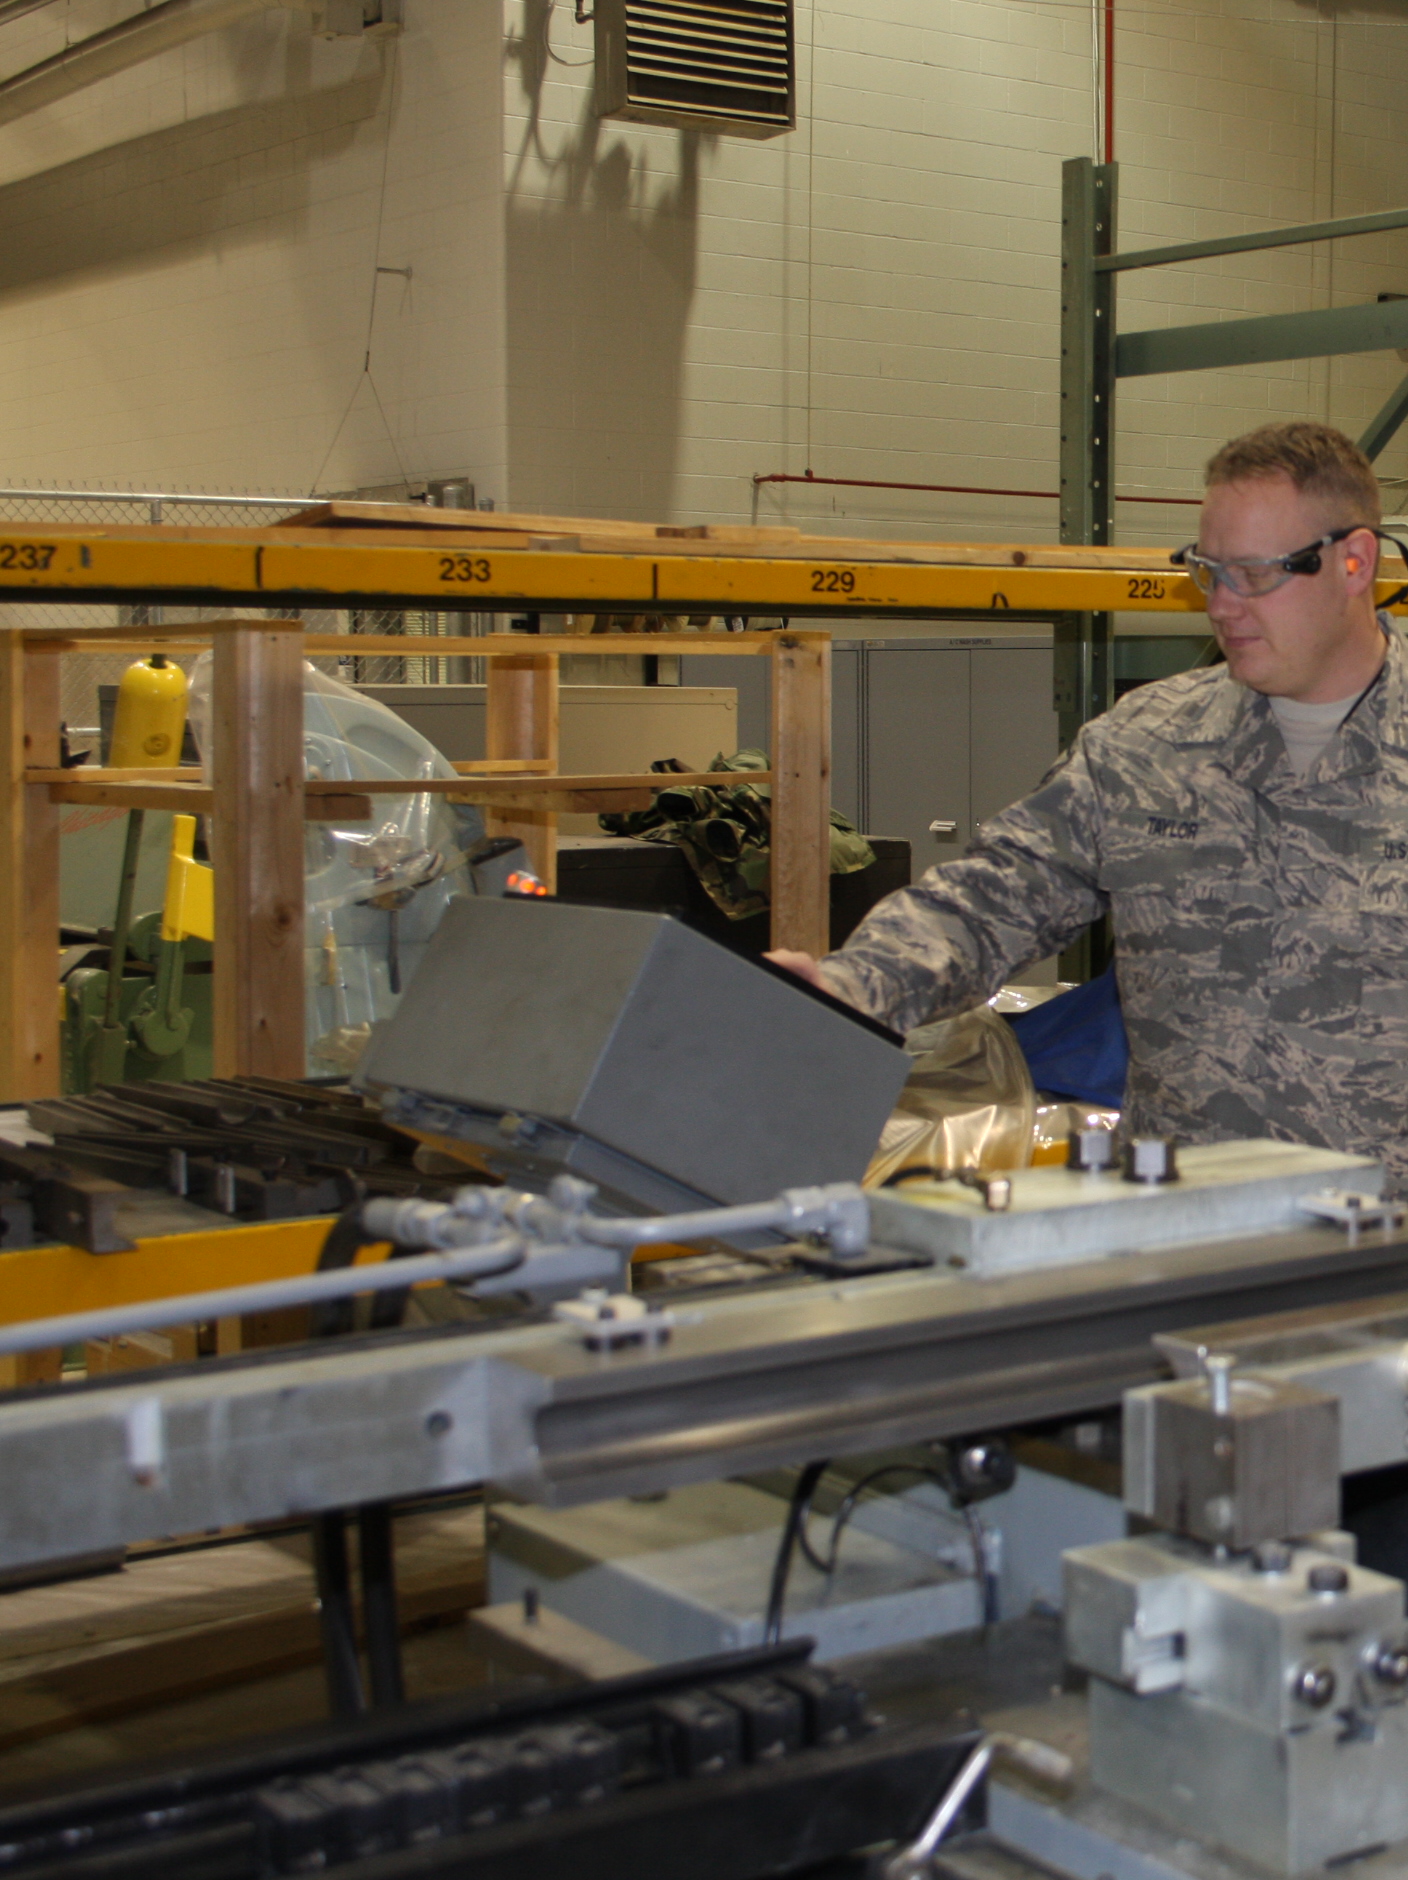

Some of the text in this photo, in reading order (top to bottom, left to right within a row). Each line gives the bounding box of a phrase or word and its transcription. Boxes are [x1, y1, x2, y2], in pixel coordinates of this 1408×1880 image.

[0, 544, 58, 571] 237
[439, 558, 492, 582] 233
[811, 570, 855, 593] 229
[1128, 578, 1166, 599] 225
[1147, 816, 1199, 840] TAYLOR
